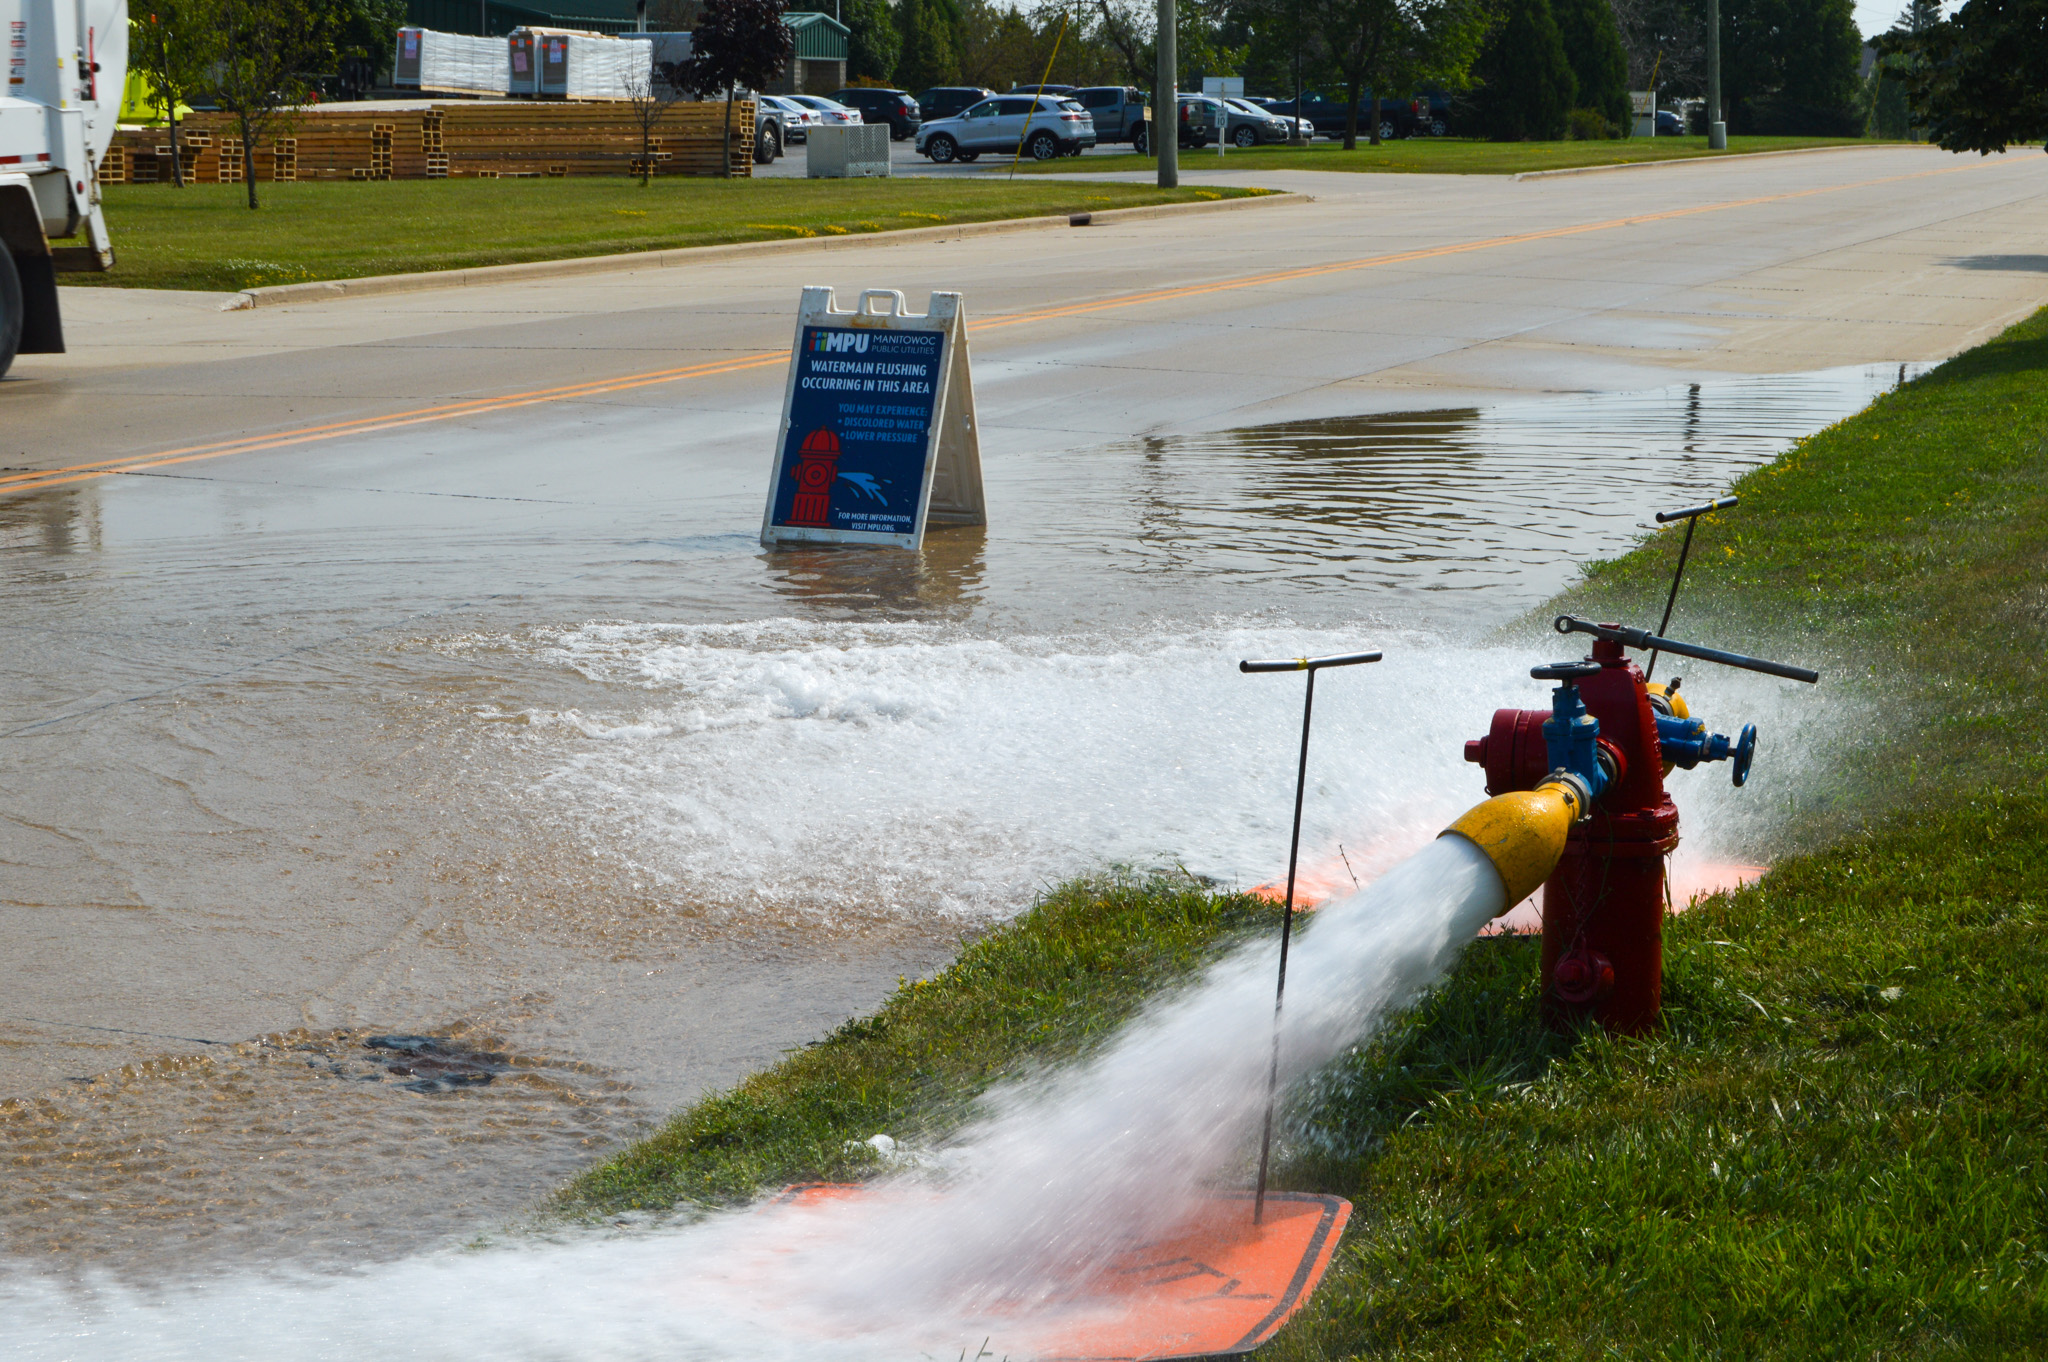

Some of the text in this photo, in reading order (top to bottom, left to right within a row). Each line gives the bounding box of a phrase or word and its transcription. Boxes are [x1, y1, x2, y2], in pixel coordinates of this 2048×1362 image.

[1217, 117, 1225, 125] 10
[825, 332, 870, 354] MPU
[872, 335, 937, 346] MANITOWOC
[871, 344, 935, 355] PUBLIC UTILITIES
[811, 360, 927, 376] WATERMAIN FLUSHING
[801, 377, 930, 394] OCCURRING IN THIS AREA
[838, 403, 928, 416] YOU MAY EXPERIENCE:
[844, 417, 924, 430] DISCOLORED WATER
[845, 431, 918, 443] LOWER PRESSURE
[838, 512, 912, 524] FOR MORE INFORMATION,
